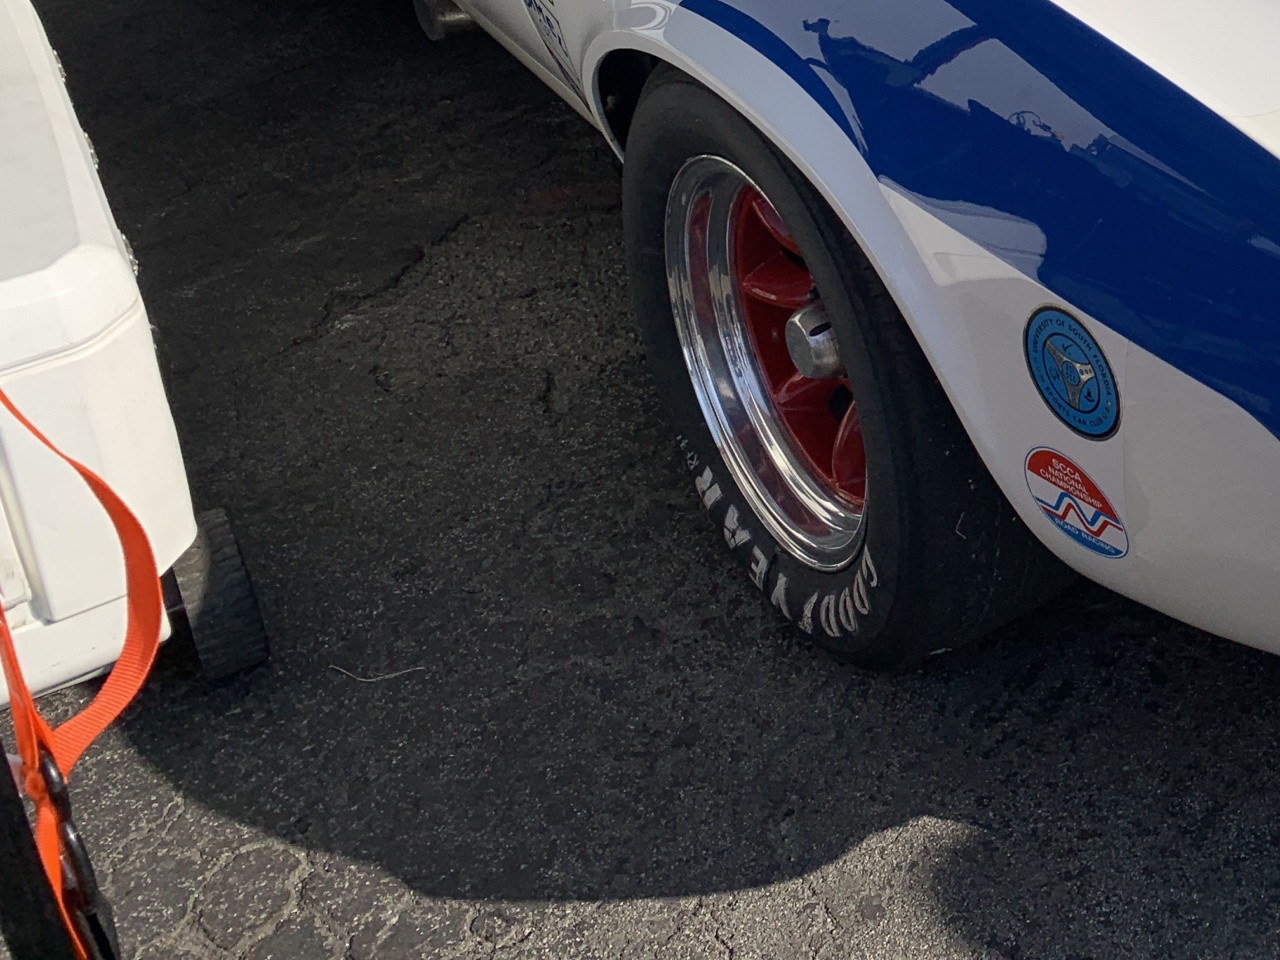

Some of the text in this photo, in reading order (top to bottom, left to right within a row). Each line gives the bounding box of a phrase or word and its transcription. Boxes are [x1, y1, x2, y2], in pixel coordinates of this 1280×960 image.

[1032, 319, 1053, 354] UNIVERSITY
[1056, 319, 1065, 328] OF
[1068, 324, 1092, 352] SOUTH
[1045, 386, 1104, 428] SPORTS CAR CLUB
[1048, 466, 1089, 495] NATIONAL
[1051, 458, 1082, 482] SCCA
[1040, 468, 1103, 508] CHAMPIONSHIP
[1055, 518, 1115, 553] ROAD RACING
